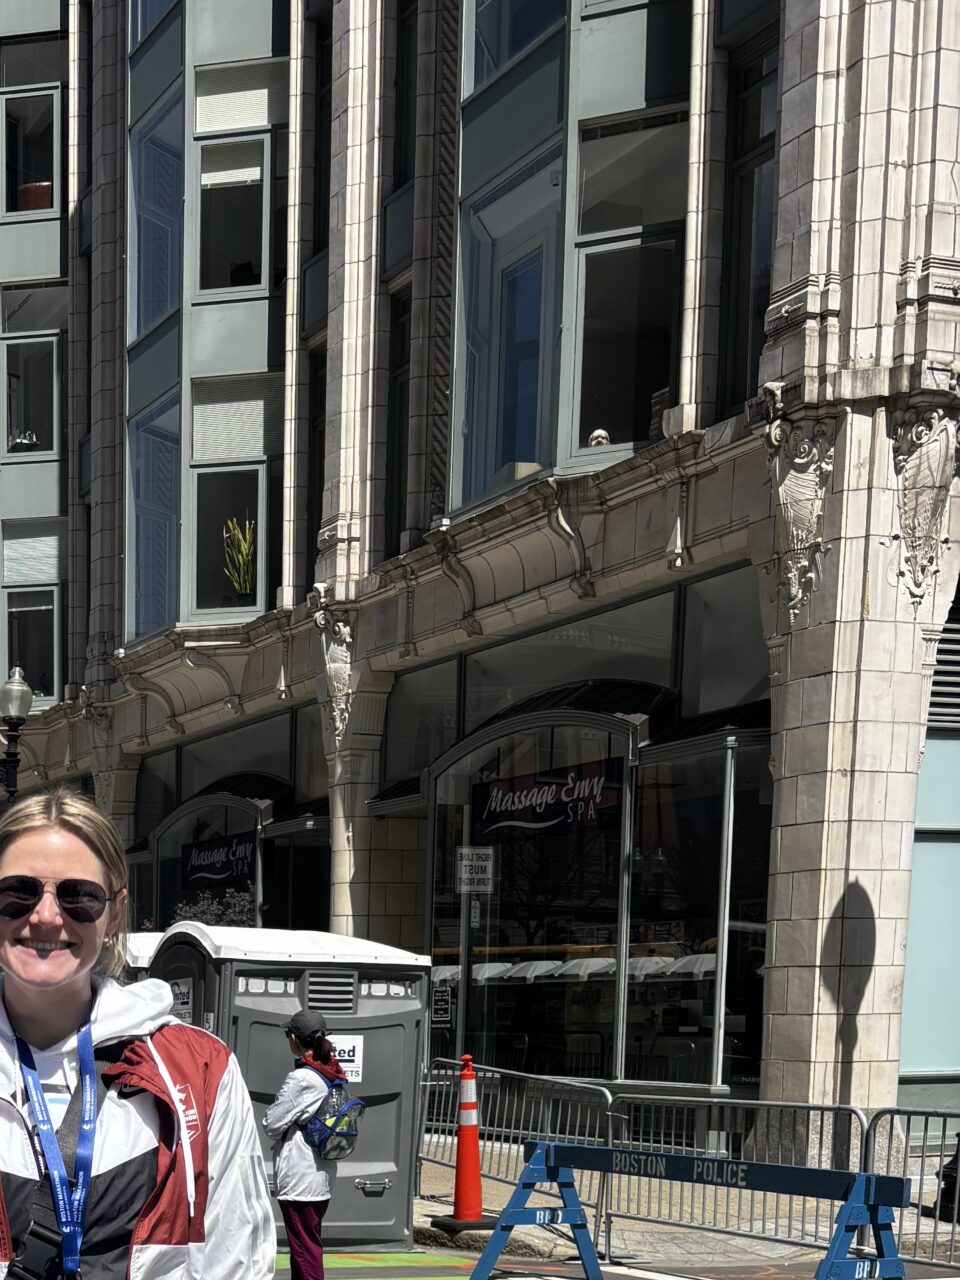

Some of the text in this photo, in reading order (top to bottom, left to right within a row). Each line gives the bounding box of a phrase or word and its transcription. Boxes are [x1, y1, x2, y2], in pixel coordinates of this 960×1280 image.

[482, 771, 605, 819] Massage Envy
[567, 799, 597, 822] SPA
[187, 838, 253, 871] Massage Envy
[233, 860, 248, 876] SPA
[612, 1152, 748, 1187] BOSTON POLICE
